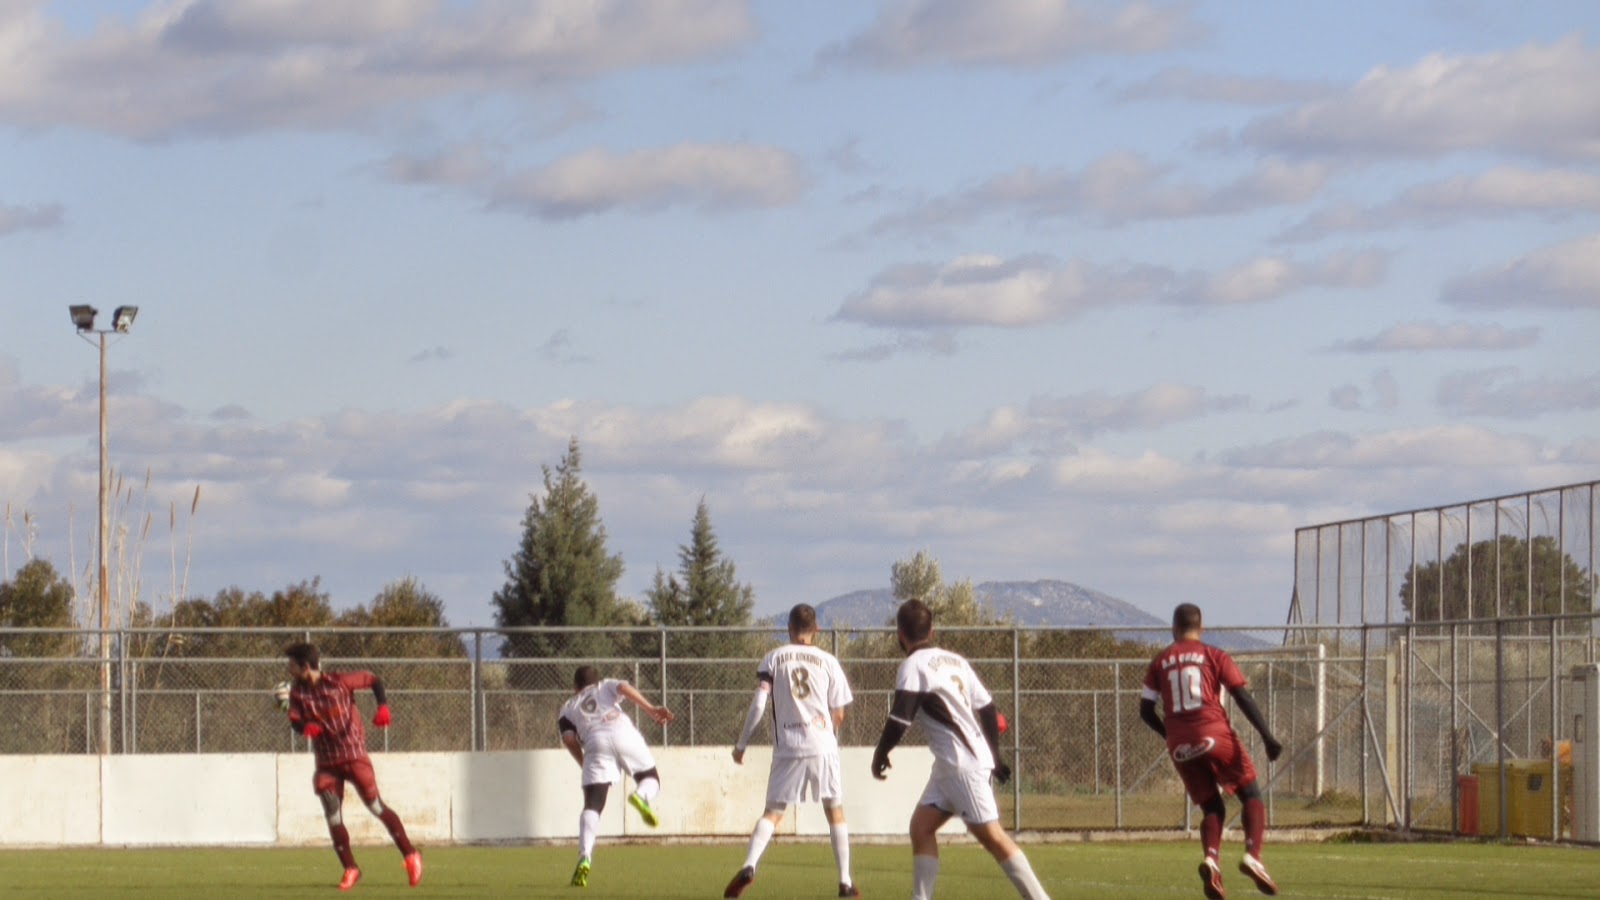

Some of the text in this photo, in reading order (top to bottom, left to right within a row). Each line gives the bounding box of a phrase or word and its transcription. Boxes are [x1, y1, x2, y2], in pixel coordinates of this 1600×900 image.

[791, 666, 811, 700] 8
[1168, 665, 1202, 713] 10
[580, 693, 598, 714] 6
